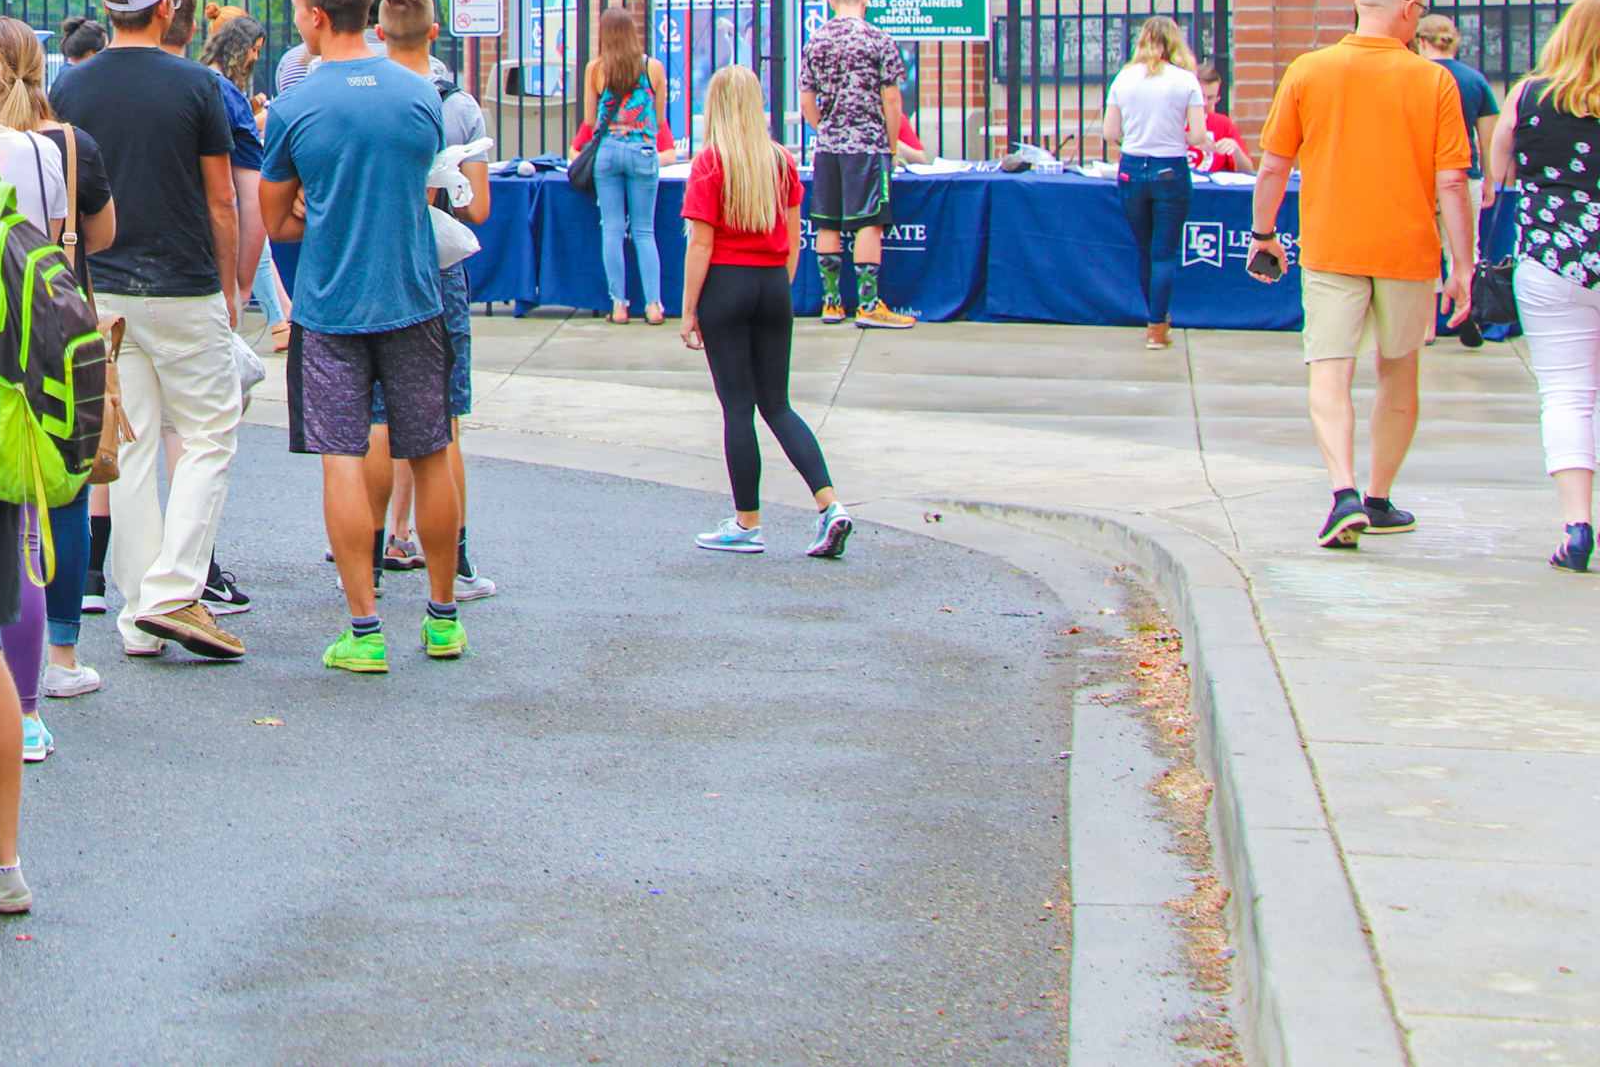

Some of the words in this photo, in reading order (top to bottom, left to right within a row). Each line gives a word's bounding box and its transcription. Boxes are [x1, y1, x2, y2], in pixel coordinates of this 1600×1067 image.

[891, 8, 921, 16] PETS
[879, 15, 934, 24] SMOKING
[913, 26, 946, 34] HARRIS
[947, 26, 973, 34] FIELD
